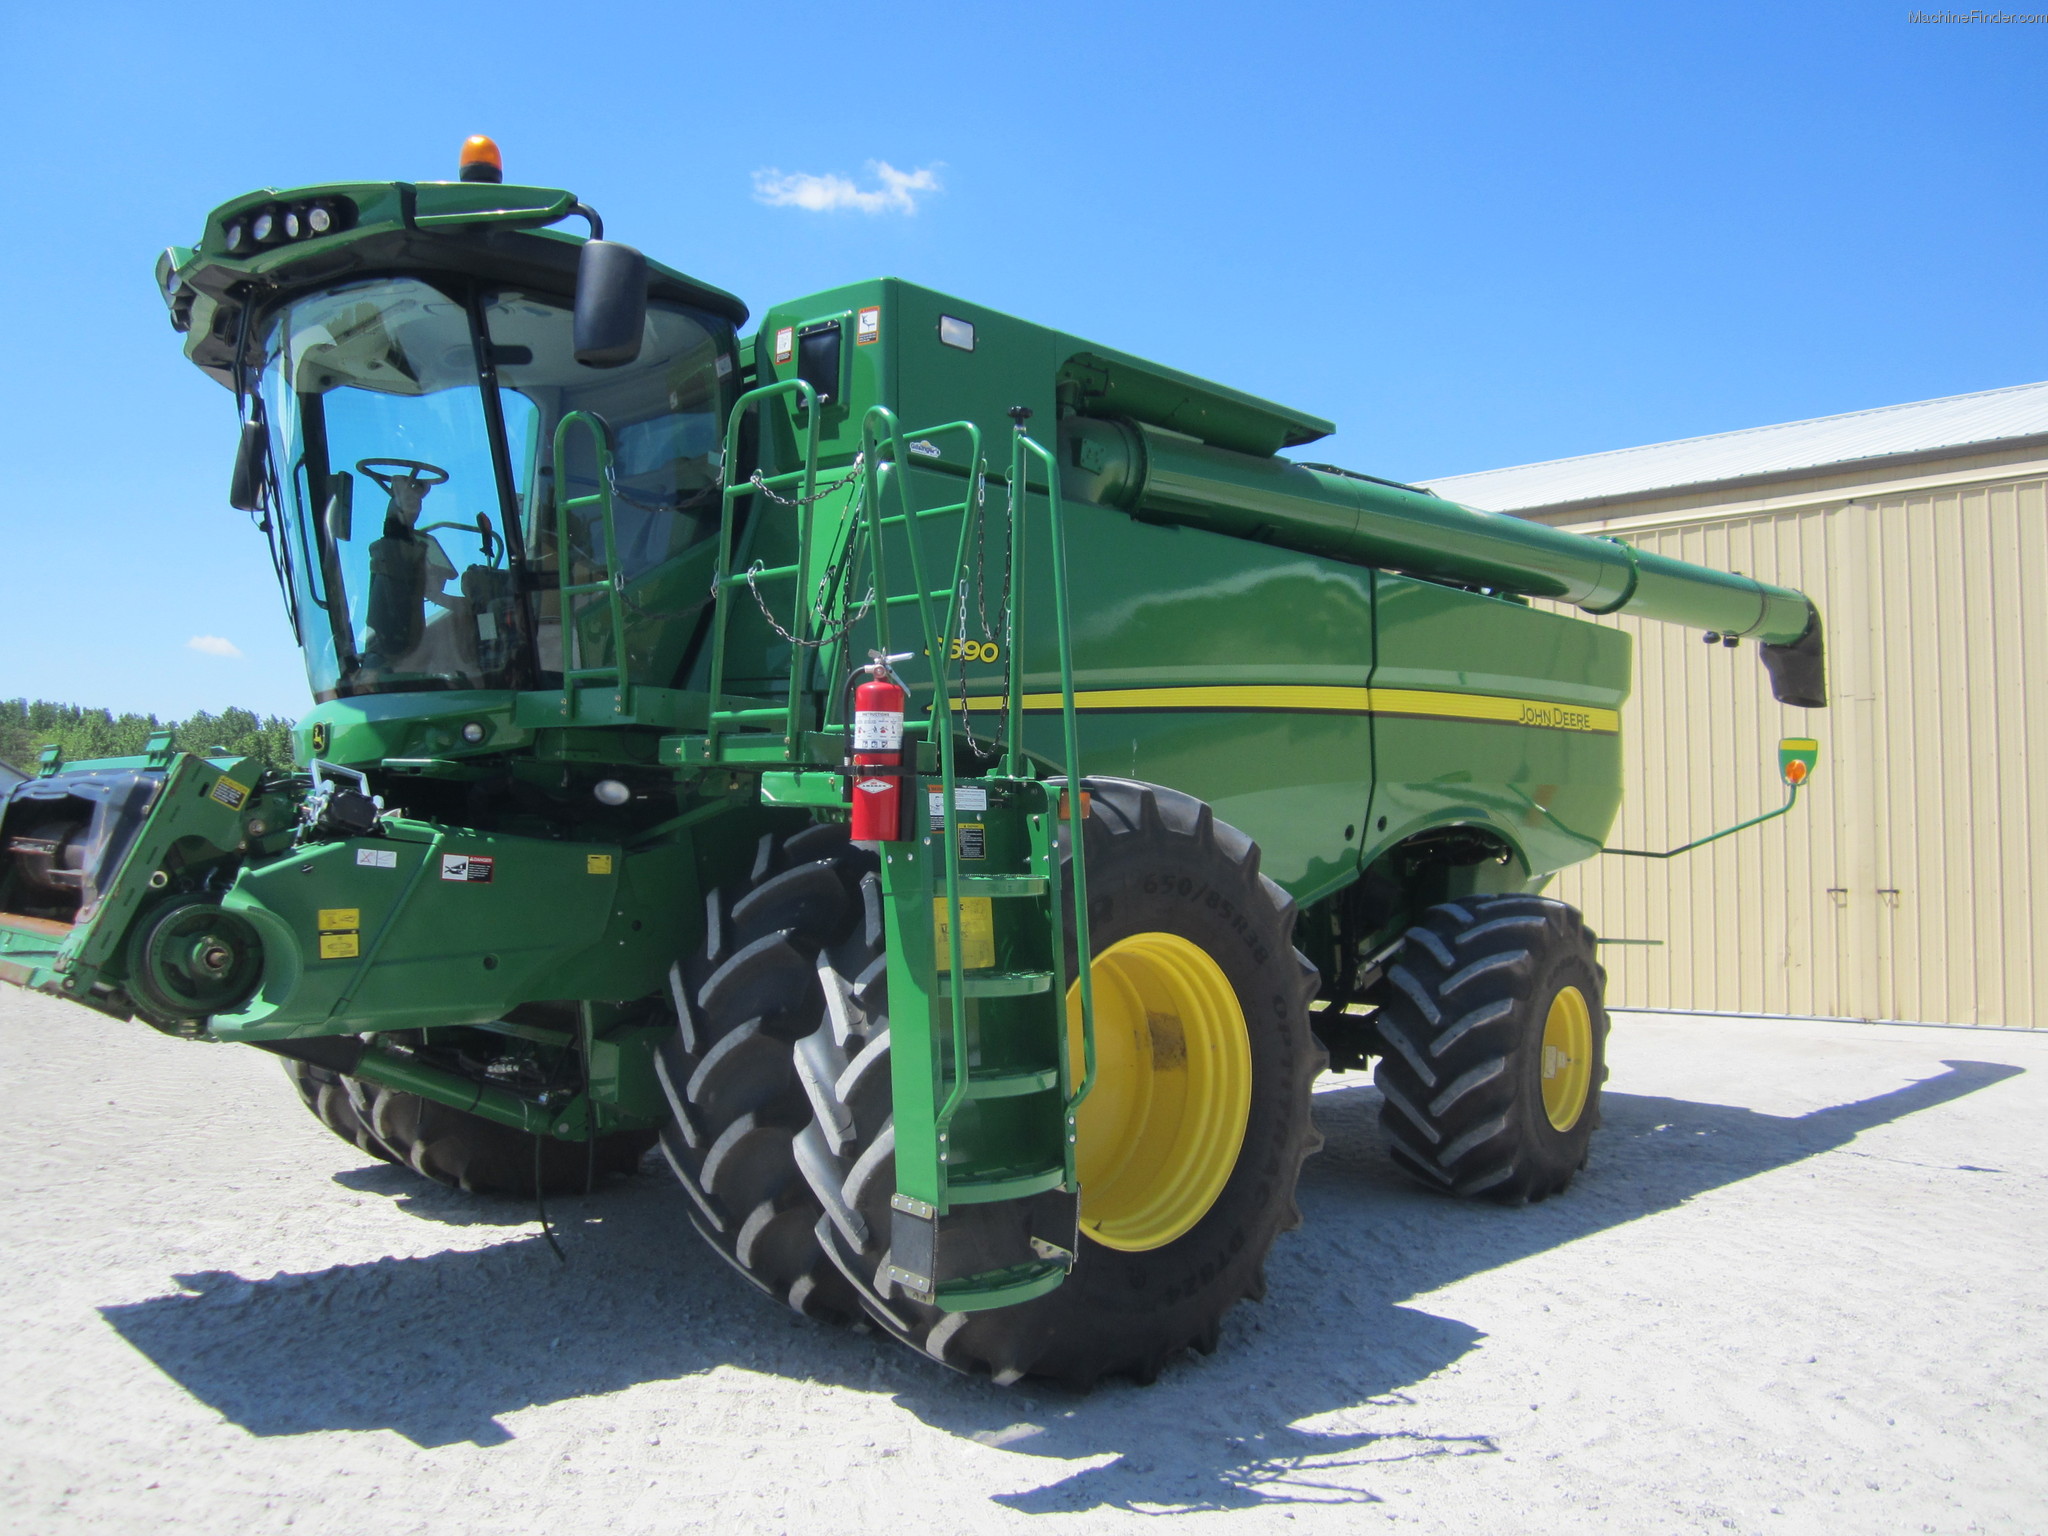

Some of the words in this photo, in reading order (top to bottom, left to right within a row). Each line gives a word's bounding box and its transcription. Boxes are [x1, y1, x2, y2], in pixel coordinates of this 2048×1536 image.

[924, 637, 999, 664] 690
[1519, 703, 1552, 724] JOHN
[1553, 707, 1591, 729] DEERE
